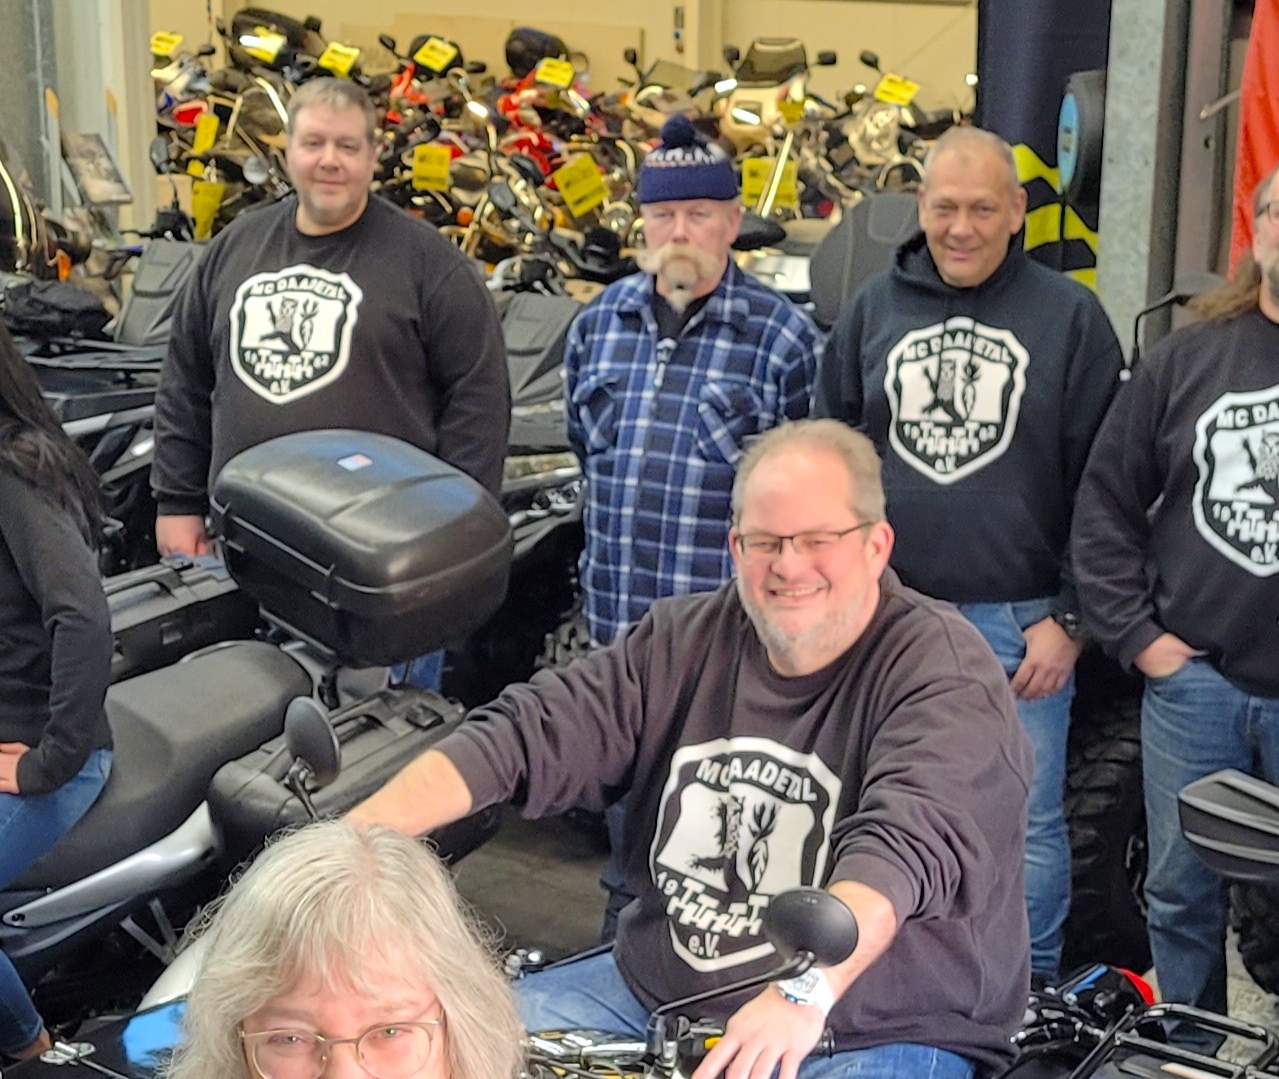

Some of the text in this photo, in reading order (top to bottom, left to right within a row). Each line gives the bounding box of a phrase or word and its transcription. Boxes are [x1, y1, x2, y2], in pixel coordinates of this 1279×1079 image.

[1216, 408, 1250, 429] MC
[655, 870, 680, 897] 19
[687, 932, 721, 959] e.V.
